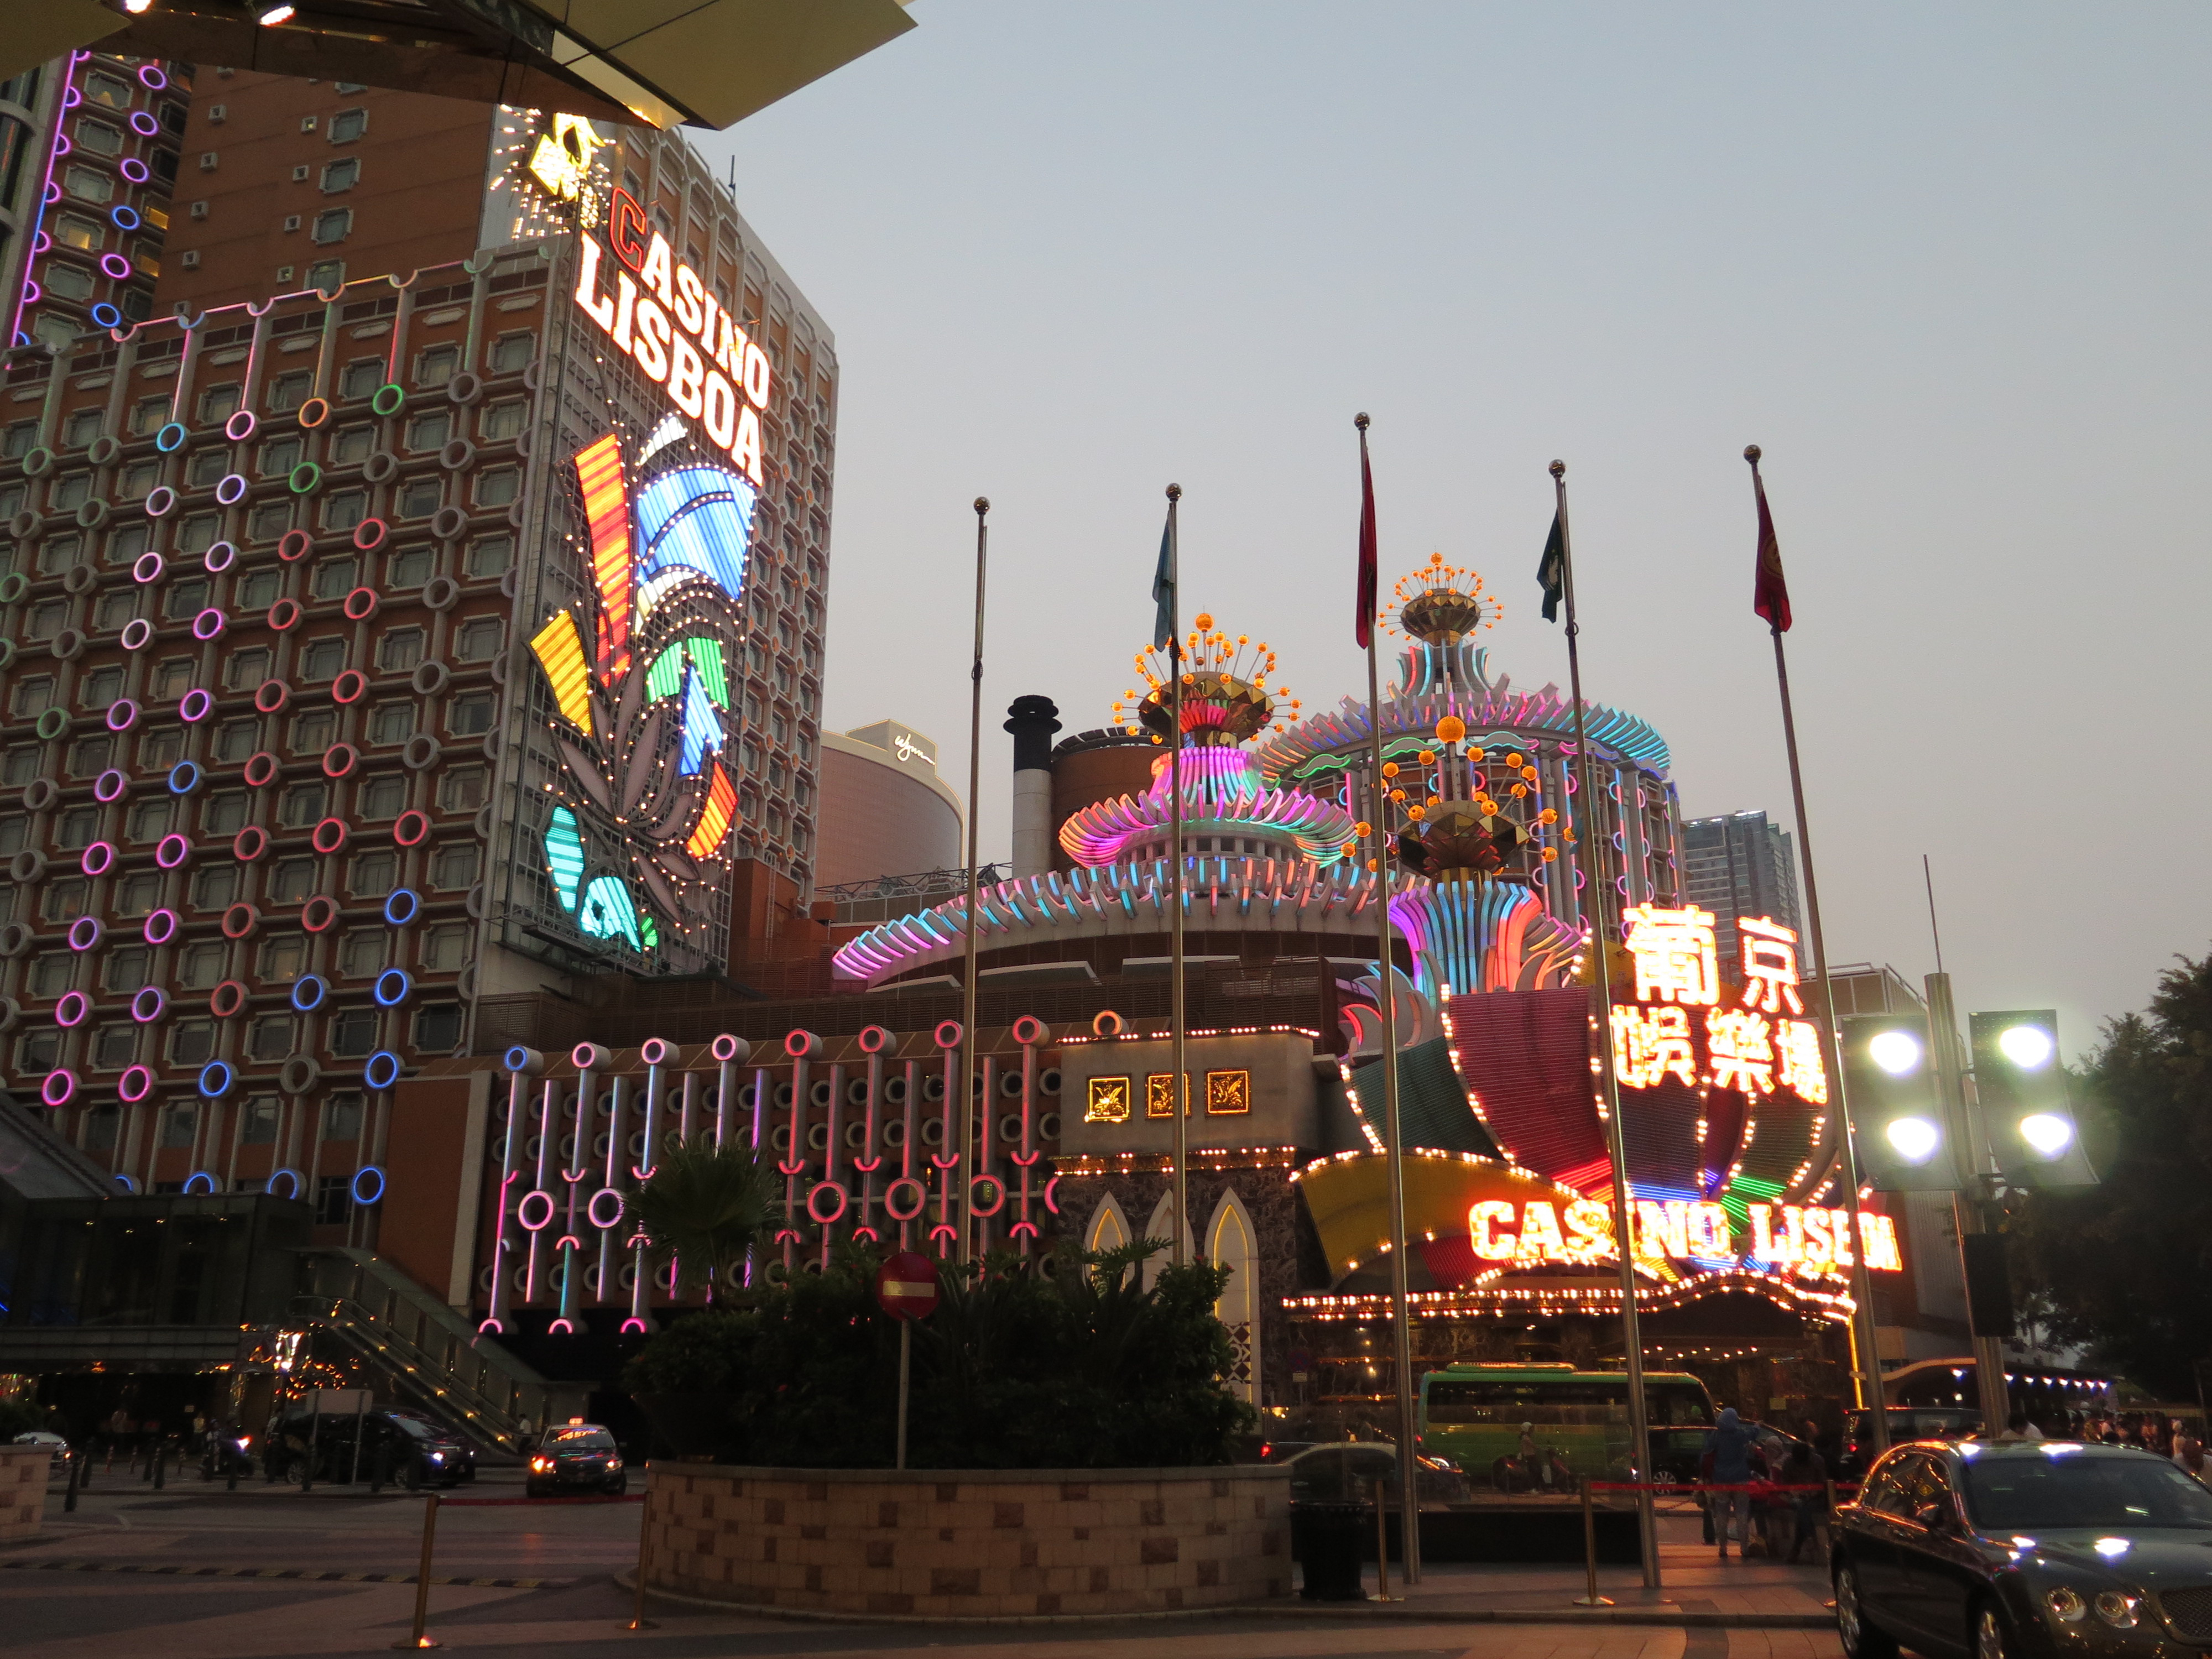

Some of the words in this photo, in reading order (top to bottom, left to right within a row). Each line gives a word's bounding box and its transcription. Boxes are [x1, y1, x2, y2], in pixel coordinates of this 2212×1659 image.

[575, 230, 763, 487] LISBOA
[610, 187, 770, 410] CASINO
[1623, 902, 1805, 1015] 葡京
